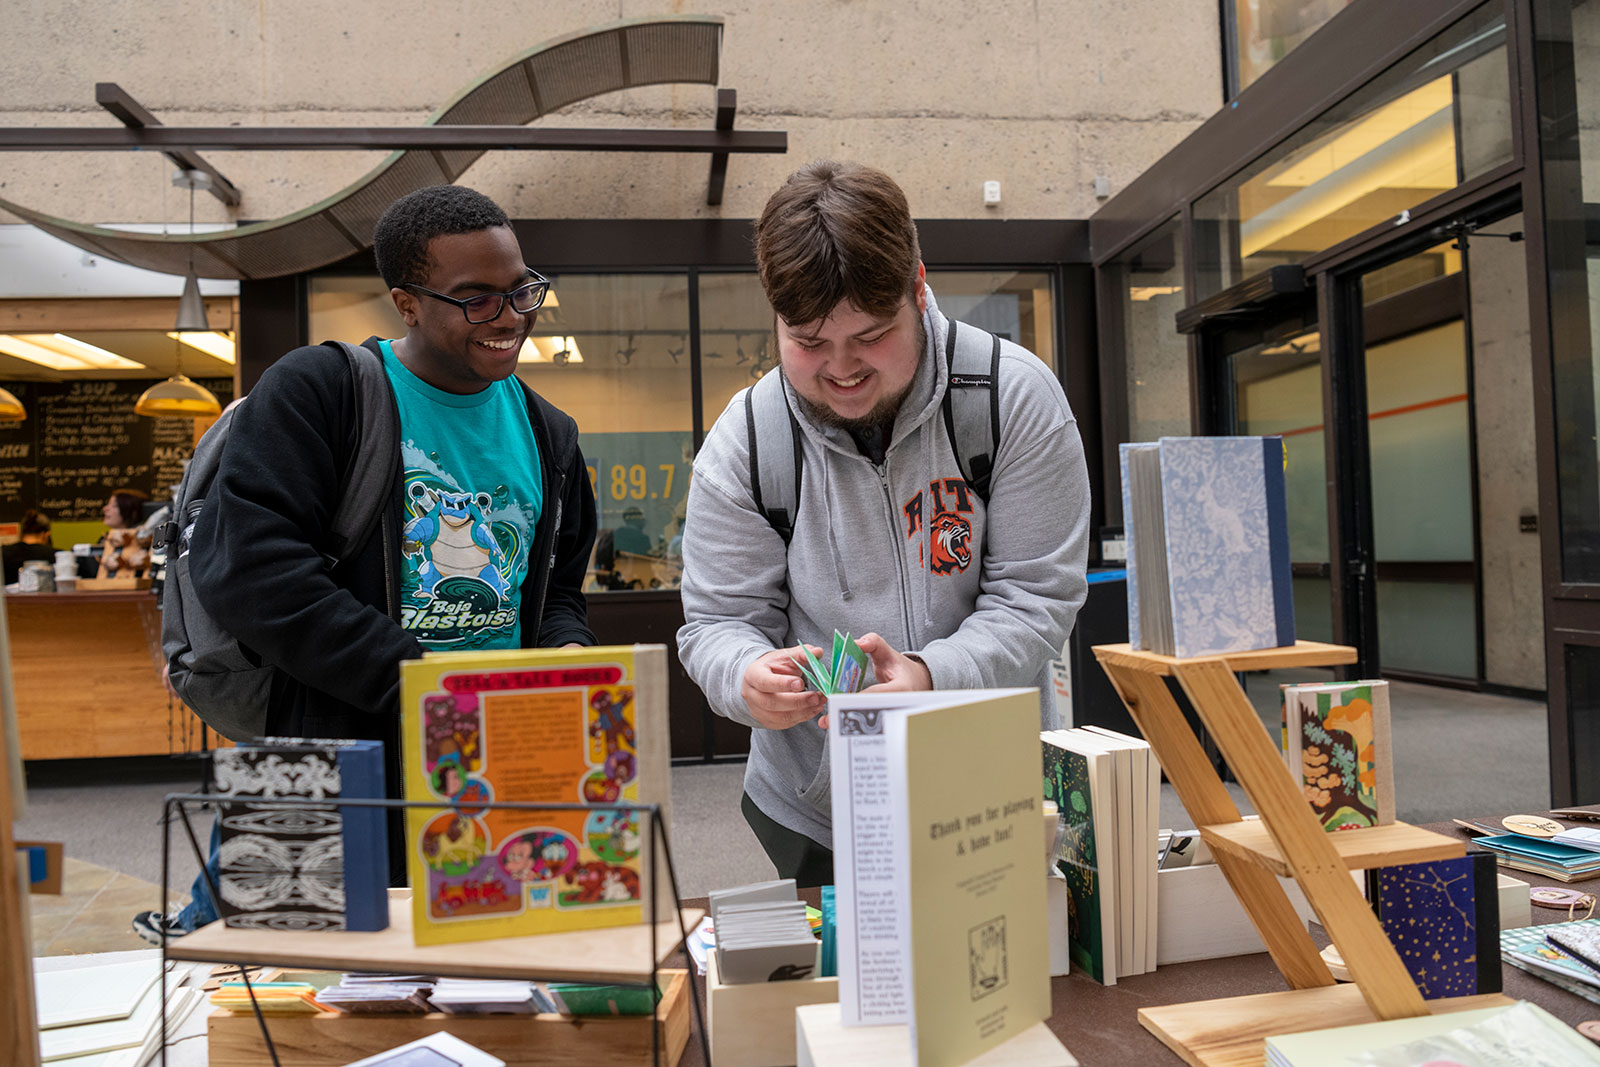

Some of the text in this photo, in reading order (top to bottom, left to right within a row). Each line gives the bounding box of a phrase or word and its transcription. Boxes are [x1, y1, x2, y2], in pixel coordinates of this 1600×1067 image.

[611, 464, 675, 500] 89.7
[903, 477, 975, 540] RIT
[400, 609, 516, 630] Blastoise
[432, 600, 473, 616] Baja
[930, 797, 1035, 840] Thank you for playing
[956, 824, 1013, 856] & have fun!
